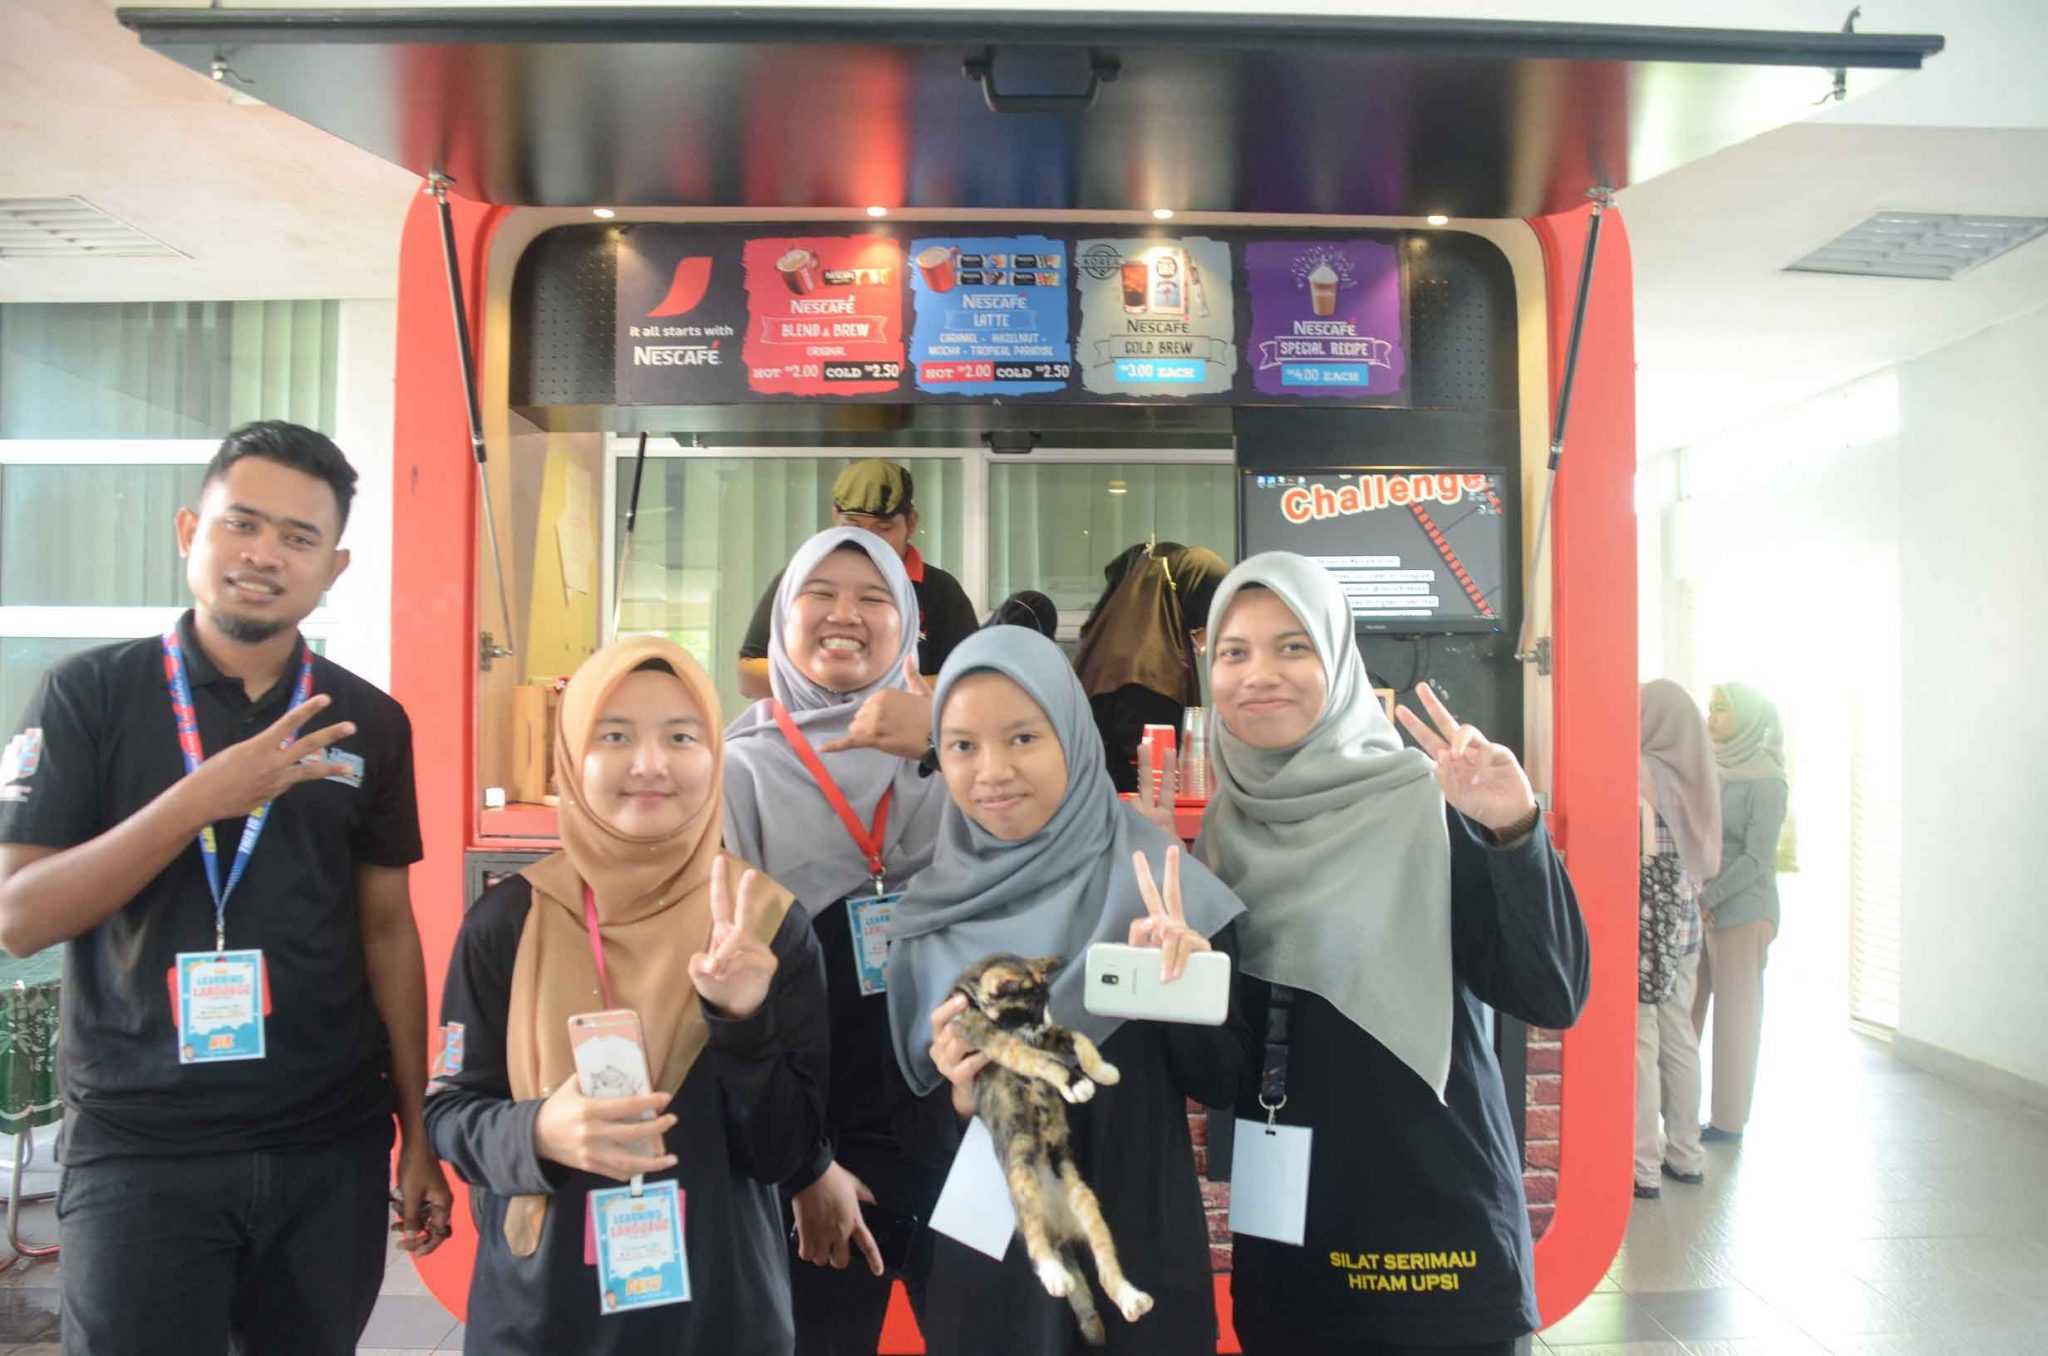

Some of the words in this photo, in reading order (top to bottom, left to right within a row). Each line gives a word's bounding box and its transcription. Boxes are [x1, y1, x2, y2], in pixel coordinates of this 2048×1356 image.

[973, 313, 1010, 328] LATTE
[642, 325, 660, 337] all
[662, 325, 702, 337] starts
[704, 325, 734, 337] with
[781, 323, 820, 337] BLEND
[832, 323, 870, 337] BREW
[1125, 341, 1154, 354] COLD
[1159, 341, 1193, 354] BREW
[1280, 341, 1326, 355] SPECIAL
[1330, 342, 1369, 356] RECIPE
[753, 368, 782, 378] HOT
[825, 368, 862, 378] COLD
[925, 368, 954, 379] HOT
[996, 368, 1033, 379] COLD
[1281, 474, 1487, 524] Challenge
[1329, 1250, 1380, 1270] SILAT
[1383, 1249, 1477, 1271] SERIMAU
[1347, 1272, 1408, 1292] HITAM
[1410, 1272, 1460, 1292] UPSI
